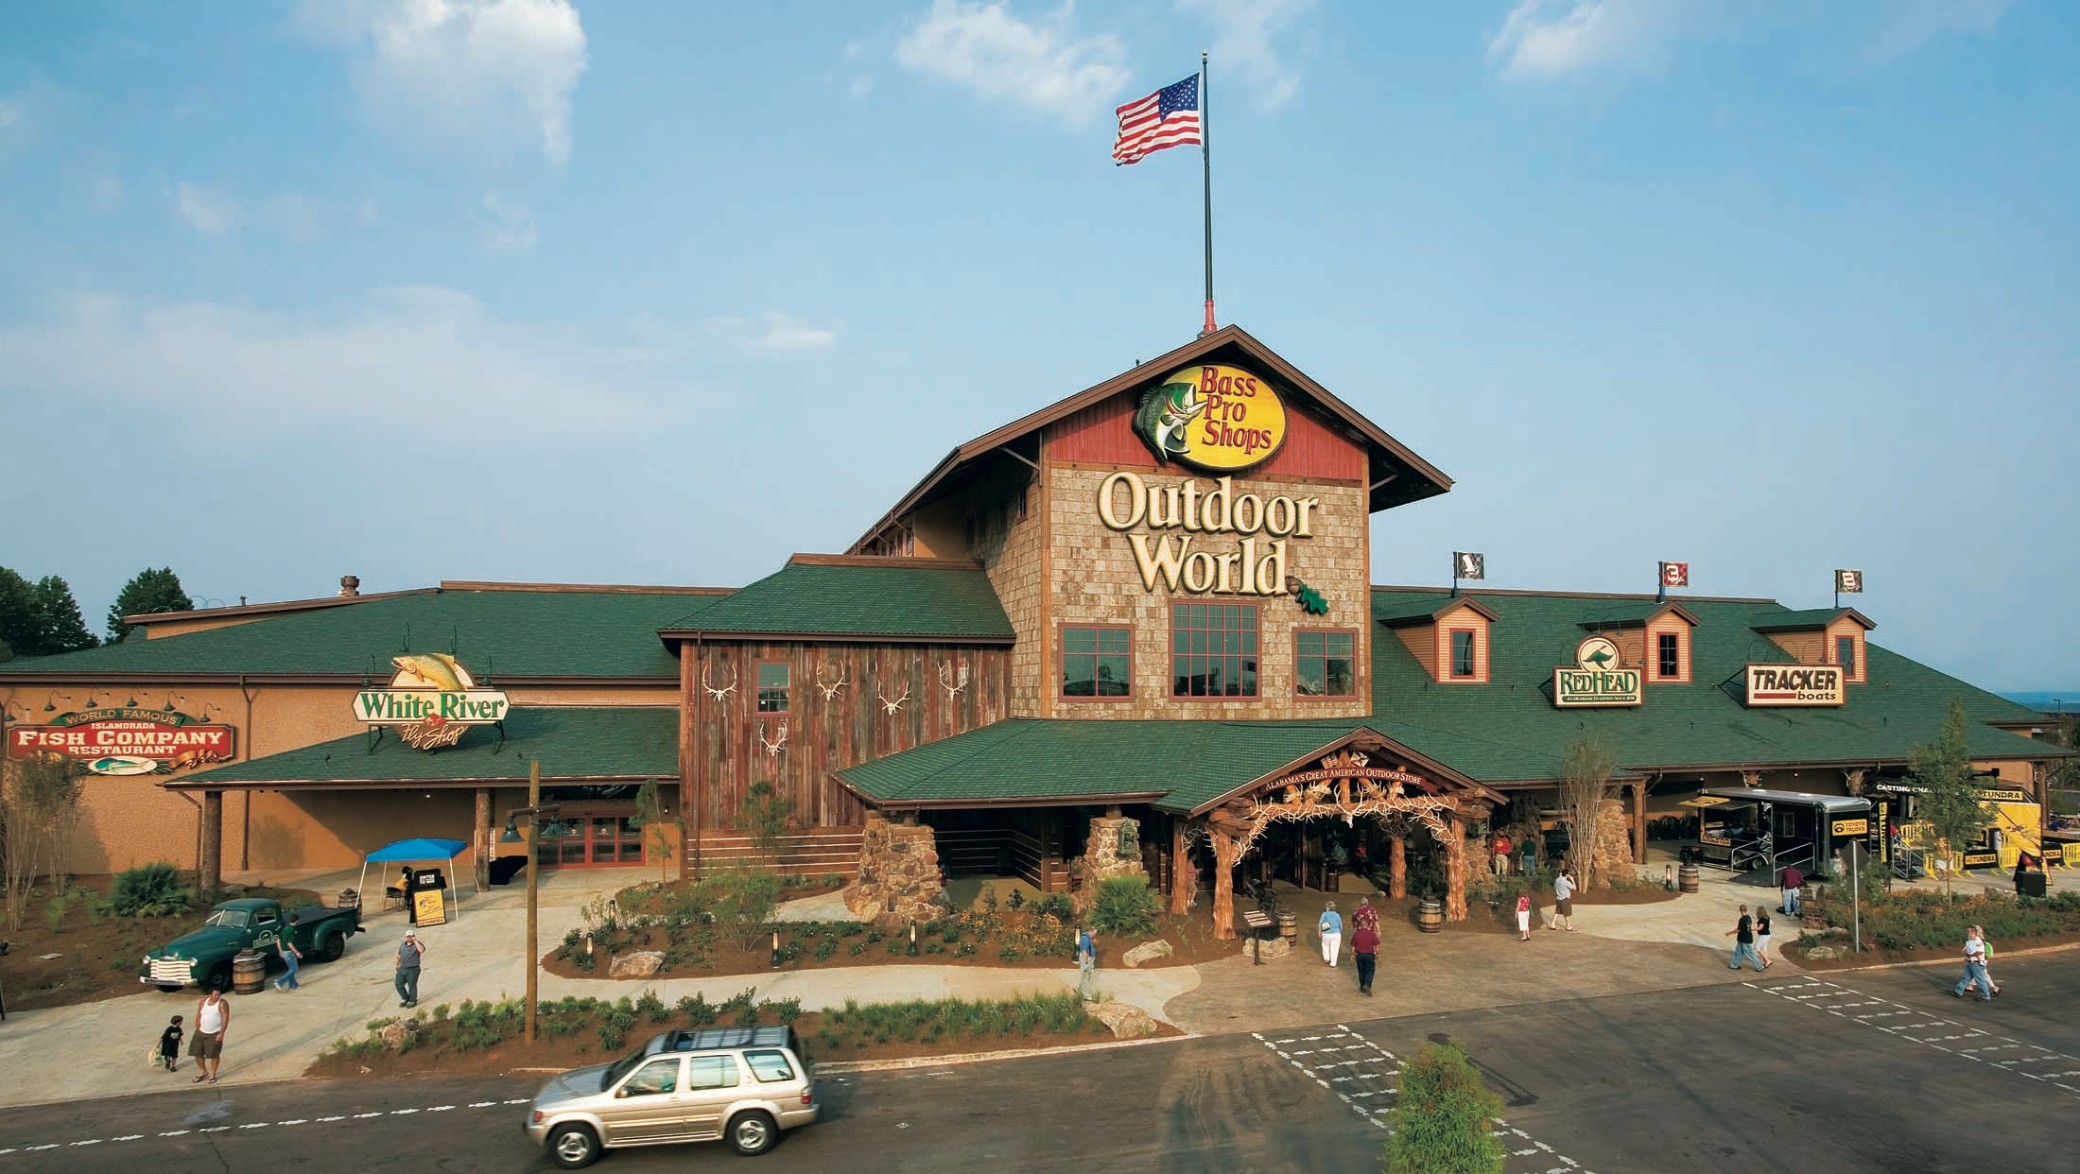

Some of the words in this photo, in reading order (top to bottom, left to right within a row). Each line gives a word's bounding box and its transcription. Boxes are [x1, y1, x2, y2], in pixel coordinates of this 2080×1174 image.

[1198, 366, 1257, 398] Bass
[1203, 394, 1247, 422] Pro
[1202, 420, 1272, 455] Shops
[1098, 471, 1319, 538] Outdoor
[1126, 533, 1288, 596] World
[1667, 565, 1679, 581] 3
[1753, 670, 1837, 690] TRACKER
[360, 692, 435, 719] White
[440, 692, 505, 720] River
[1797, 691, 1836, 700] boats
[66, 709, 116, 725] WORLD
[122, 709, 178, 726] FAMOUS
[91, 722, 156, 730] ISLAMORADA
[18, 731, 84, 746] FISH
[97, 731, 224, 745] COMPANY
[401, 723, 427, 749] Fly
[423, 725, 470, 750] Shop
[69, 746, 177, 755] RESTAURANT
[1265, 775, 1305, 791] ALABAMA'S
[1305, 771, 1329, 781] GREAT
[1329, 768, 1365, 778] AMERICAN
[1366, 768, 1400, 780] OUTDOOR
[1400, 772, 1422, 785] STORE
[1876, 784, 1911, 793] CASTING
[1983, 791, 2021, 799] TUNDRA
[1972, 855, 1996, 863] TUNDRA
